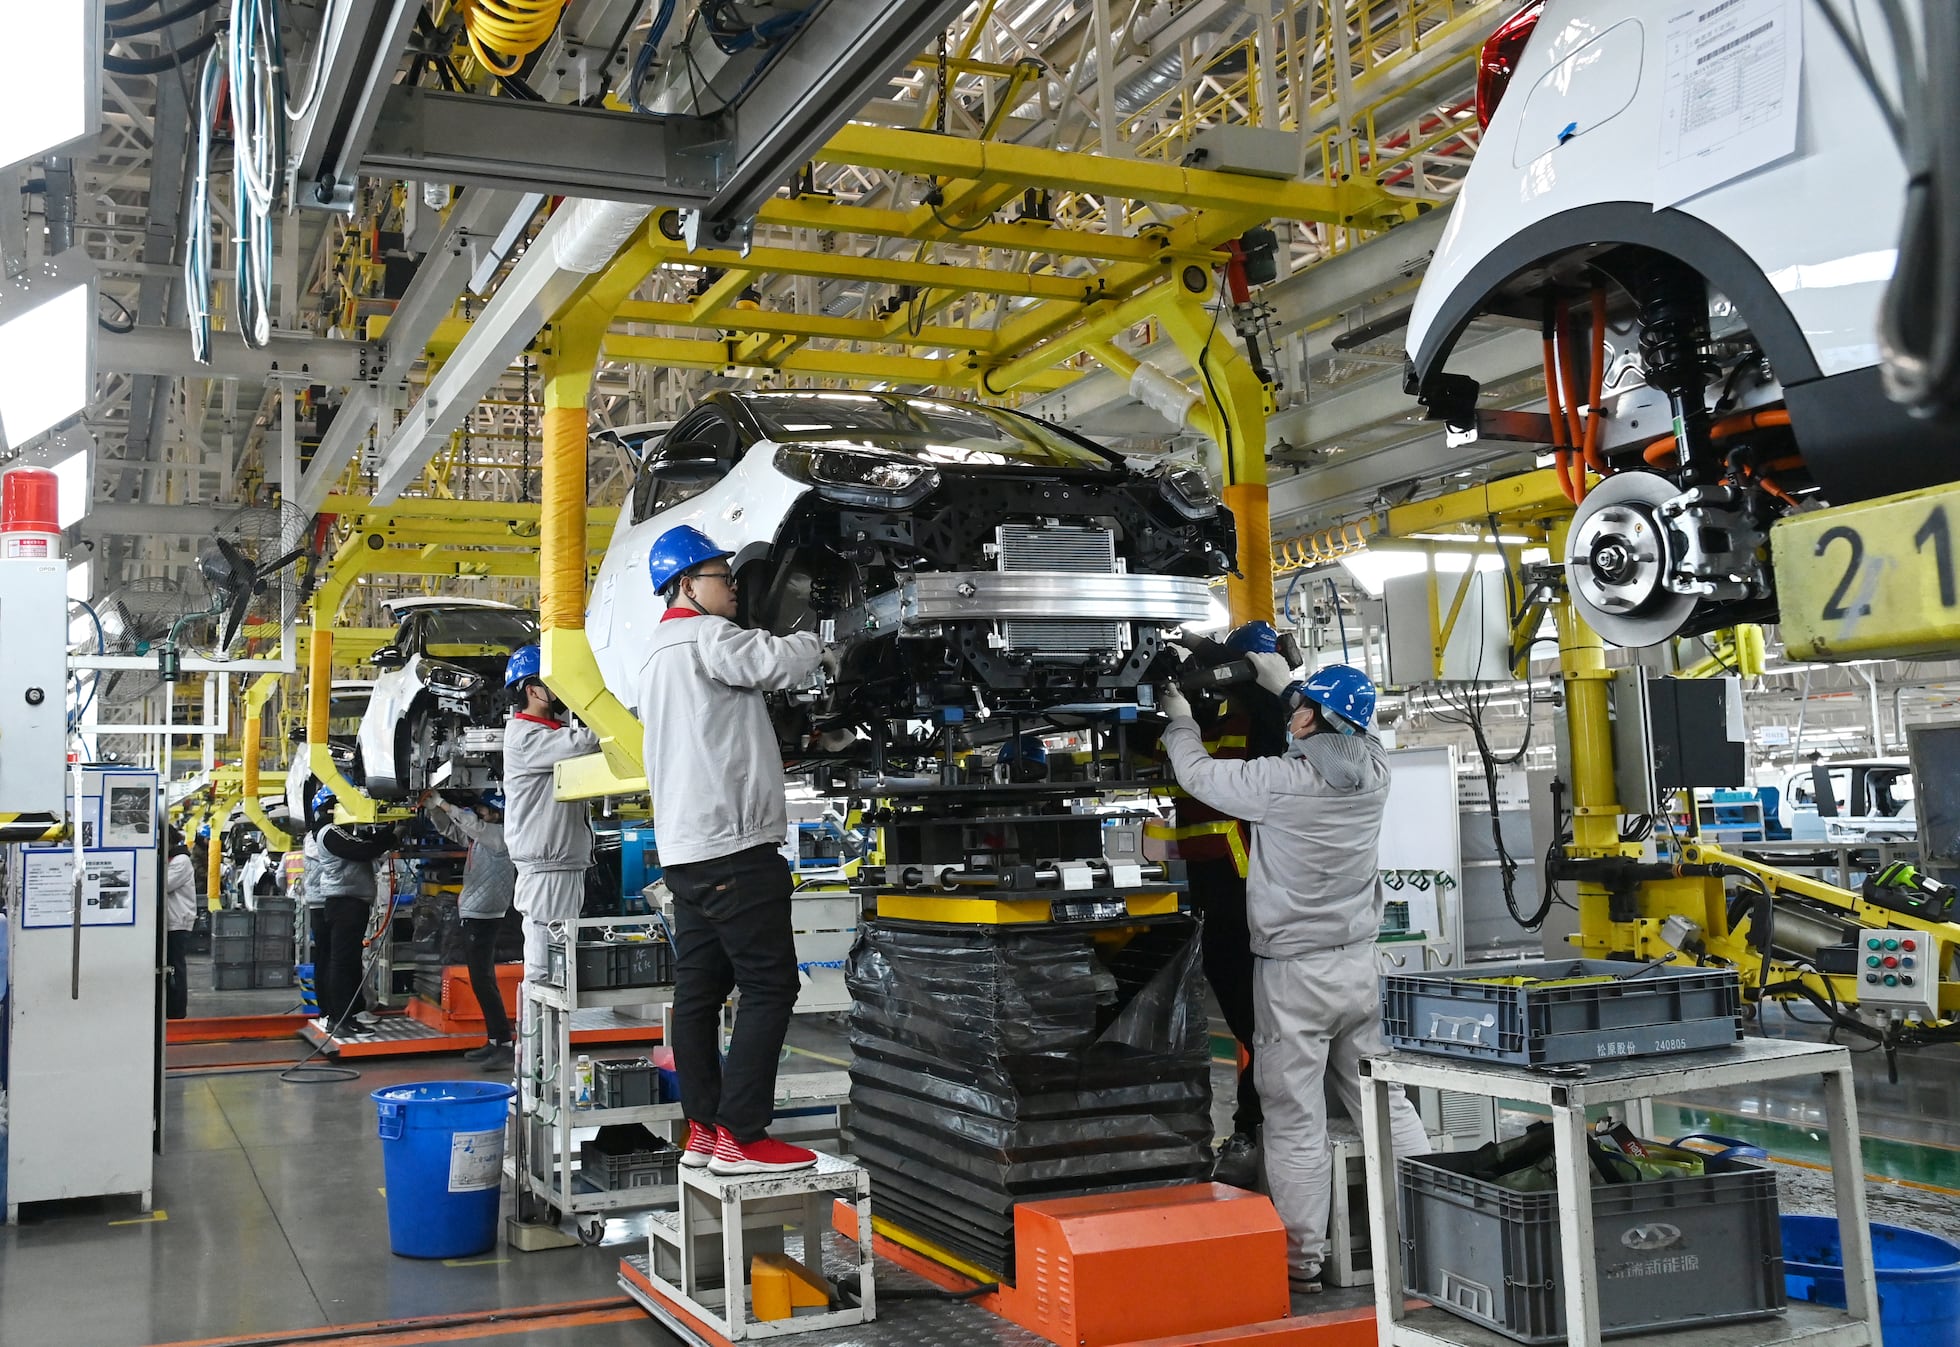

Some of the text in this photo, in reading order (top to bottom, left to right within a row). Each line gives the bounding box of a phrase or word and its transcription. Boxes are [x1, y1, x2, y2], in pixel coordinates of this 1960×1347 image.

[1814, 503, 1956, 621] 21
[1597, 1038, 1687, 1057] 松原股份 240805
